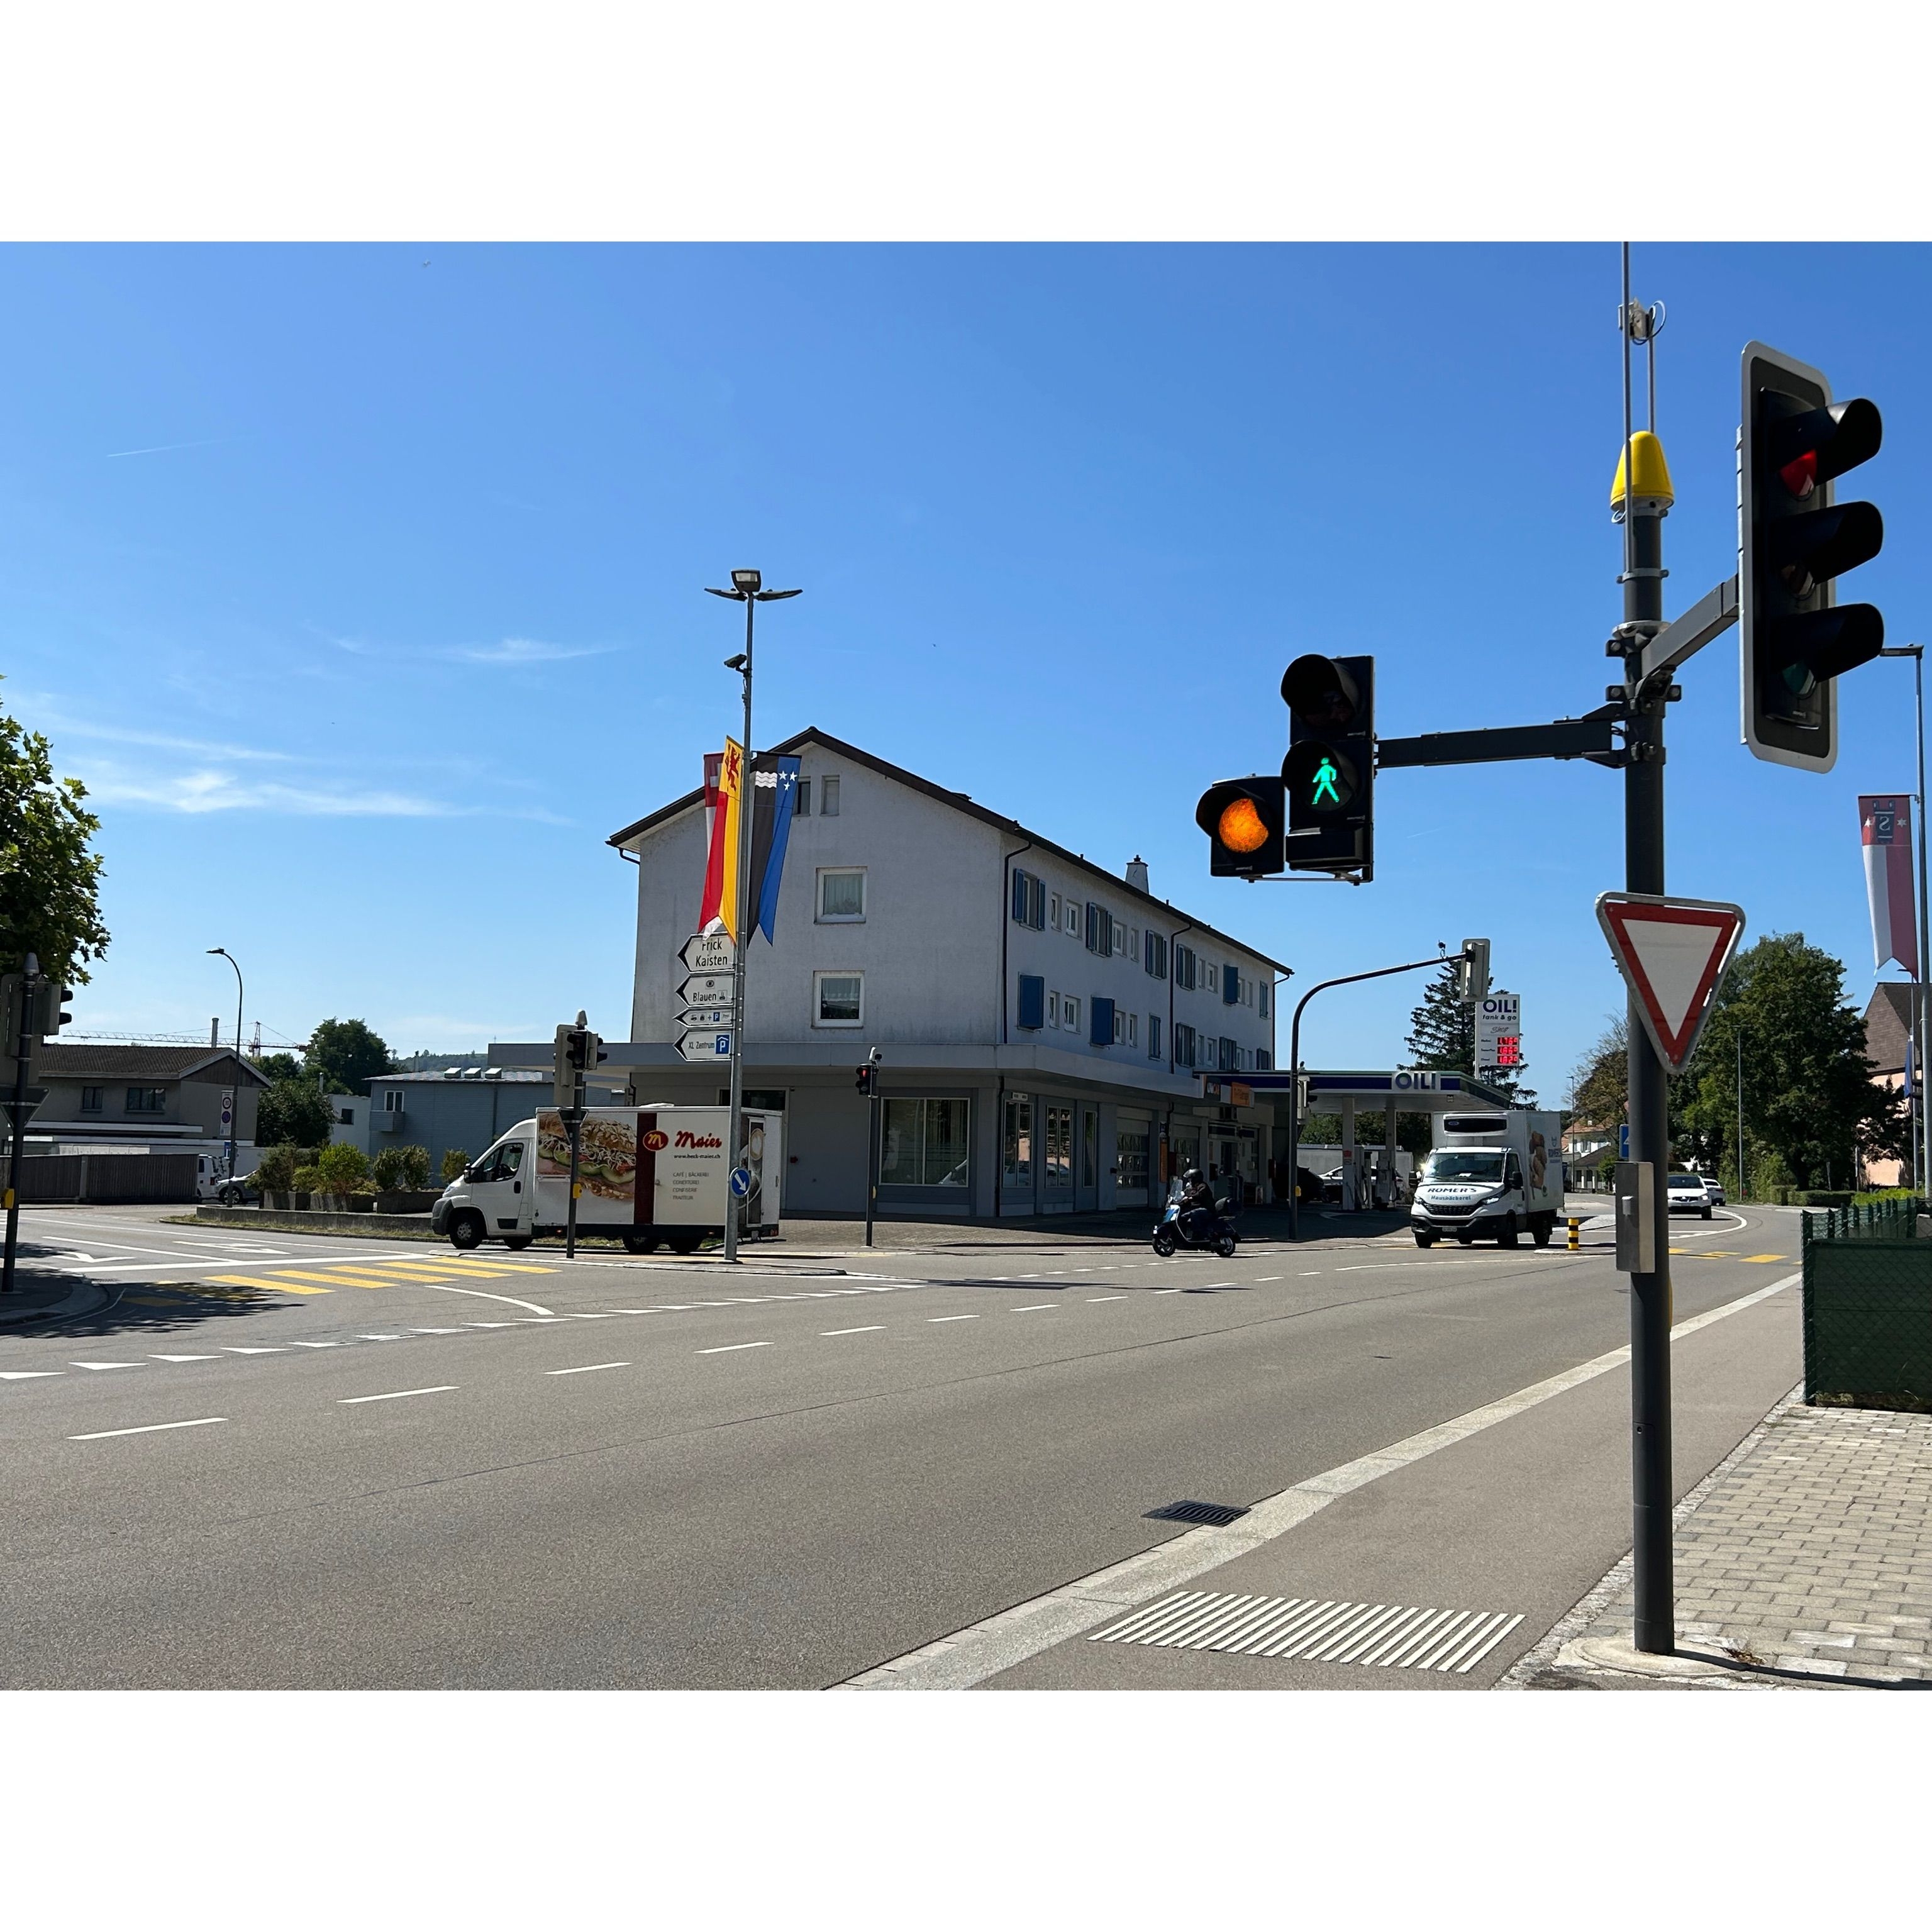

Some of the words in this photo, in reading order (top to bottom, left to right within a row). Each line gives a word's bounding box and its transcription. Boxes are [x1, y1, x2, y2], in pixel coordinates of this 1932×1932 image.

[702, 938, 723, 951] Frick
[696, 955, 728, 967] Kaisten
[692, 992, 717, 1002] Blauen
[1483, 999, 1517, 1013] OIL!
